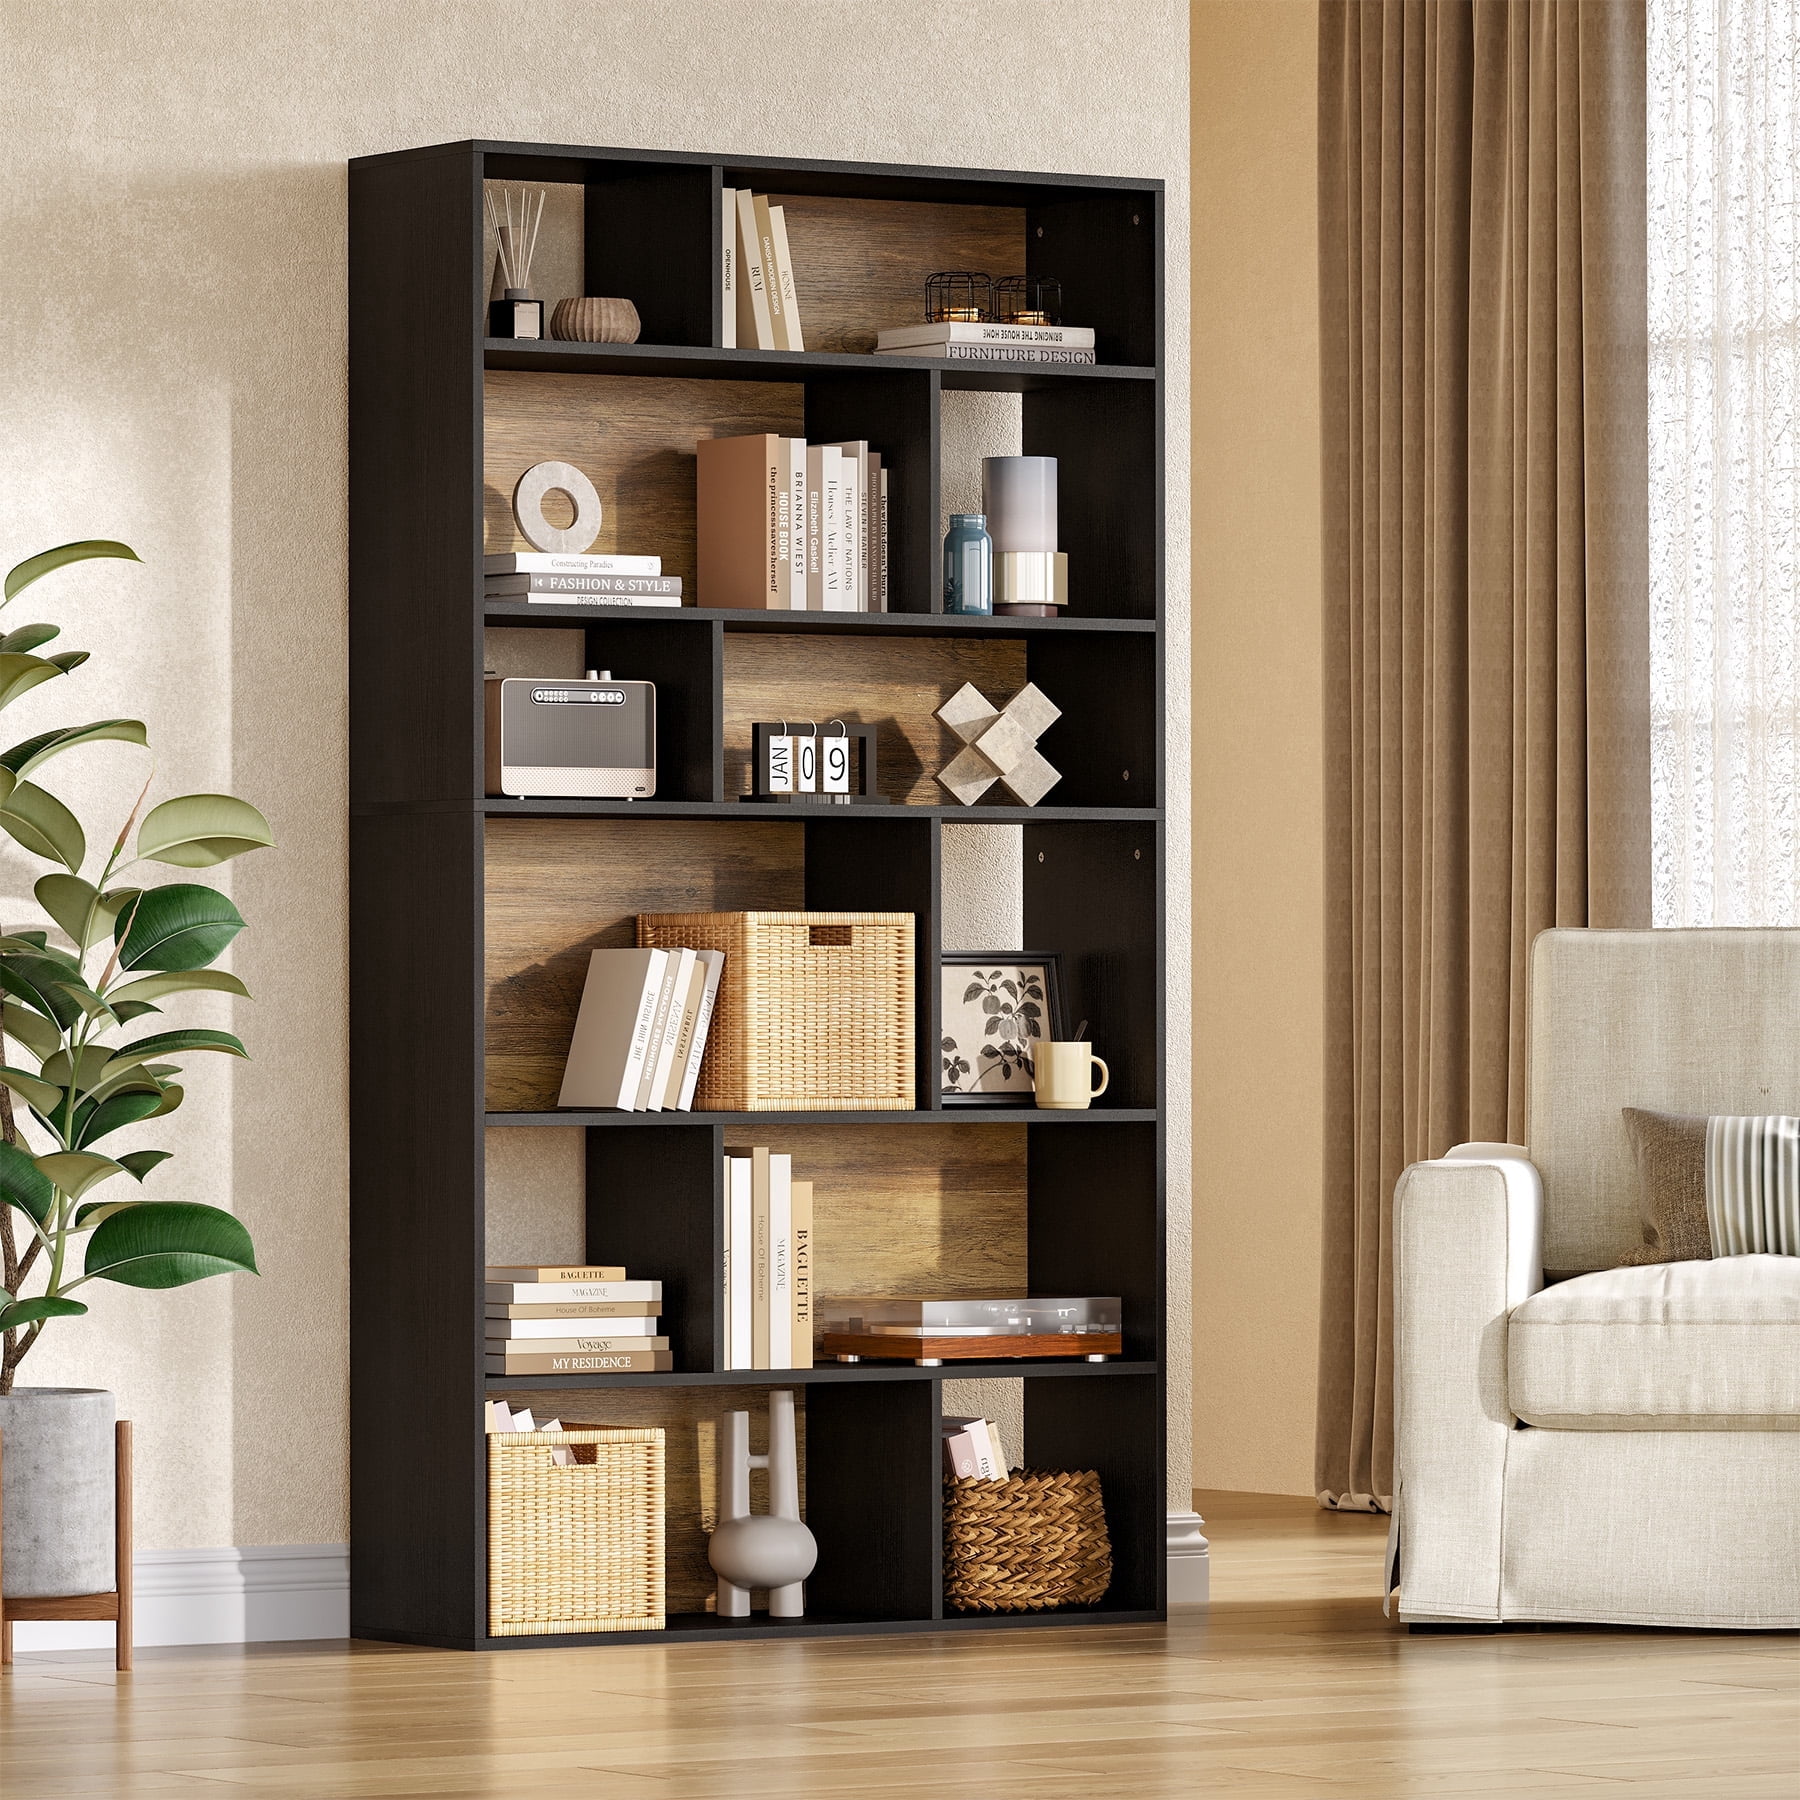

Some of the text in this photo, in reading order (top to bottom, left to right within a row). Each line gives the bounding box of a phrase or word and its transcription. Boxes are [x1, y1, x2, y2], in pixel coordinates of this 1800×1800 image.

[751, 266, 763, 292] RUM
[763, 236, 781, 315] DANISH MODERN DESIGN
[781, 271, 792, 301] HONNE
[983, 328, 1063, 342] BRINGING THE HOUSE HOME
[949, 346, 1094, 364] FURNITURE DESIGN
[770, 466, 778, 483] the
[828, 480, 838, 519] Houses
[779, 491, 789, 561] HOUSE BOOK
[795, 471, 803, 575] BRIANNA WIEST
[810, 491, 819, 573] Elizabeth Gaskell
[871, 526, 877, 535] BY
[828, 529, 838, 566] Atelier
[845, 487, 853, 591] THE LAW OF NATIONS
[551, 559, 614, 570] Constructing Paradies
[770, 557, 778, 594] herself
[549, 577, 611, 591] FASHION
[614, 579, 626, 591] &
[628, 579, 671, 593] STYLE
[828, 566, 838, 590] AM
[577, 595, 633, 607] DESIGN COLLECTION
[771, 747, 788, 785] JAN
[829, 747, 845, 781] 9
[758, 1247, 766, 1259] Of
[776, 1238, 786, 1291] MAGAZINE
[560, 1271, 605, 1280] BAGUETTE
[797, 1230, 809, 1323] BAGUETTE
[572, 1288, 609, 1297] MAGAZINE
[577, 1339, 613, 1351] Voyage
[552, 1356, 632, 1369] MY RESIDENCE
